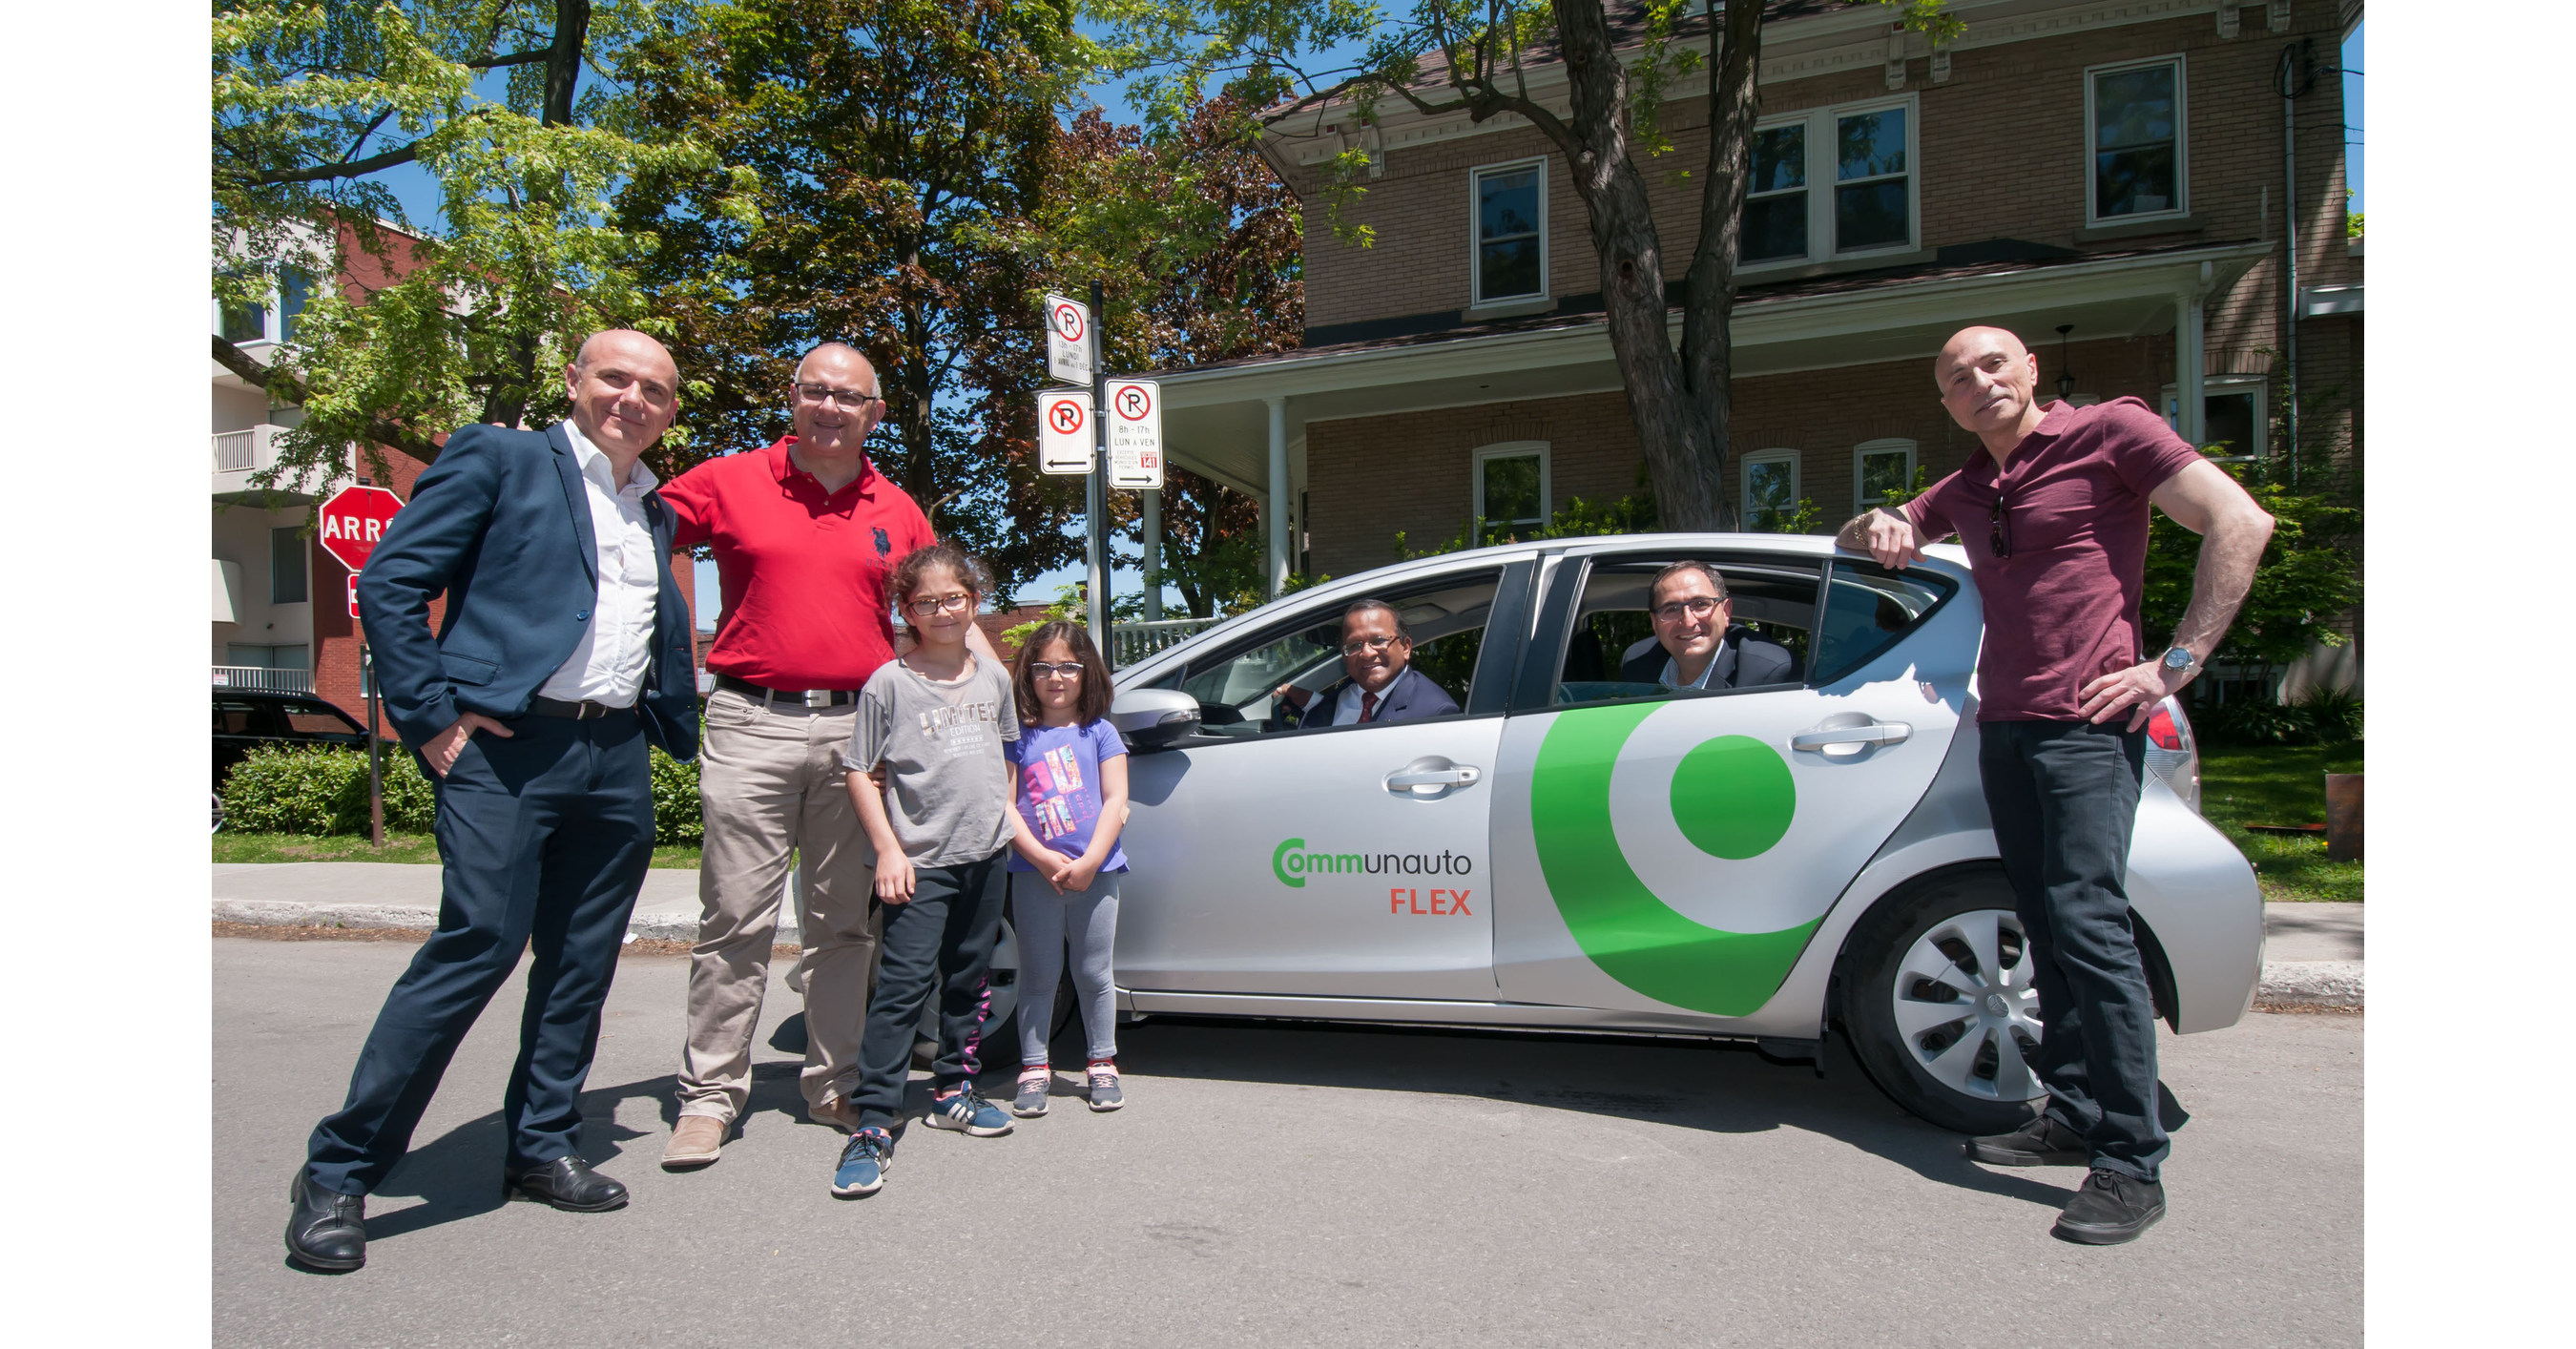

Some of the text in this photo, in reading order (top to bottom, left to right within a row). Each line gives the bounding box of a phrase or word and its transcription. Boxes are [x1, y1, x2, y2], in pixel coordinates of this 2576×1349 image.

[1118, 425, 1129, 434] 8h
[1136, 425, 1151, 434] 17h
[1114, 438, 1131, 446] LUN
[1139, 438, 1155, 446] VEN
[1143, 457, 1155, 467] 141
[324, 514, 394, 542] ARR
[949, 723, 981, 737] EDITION
[1272, 838, 1472, 888] Communauto
[1390, 888, 1472, 916] FLEX
